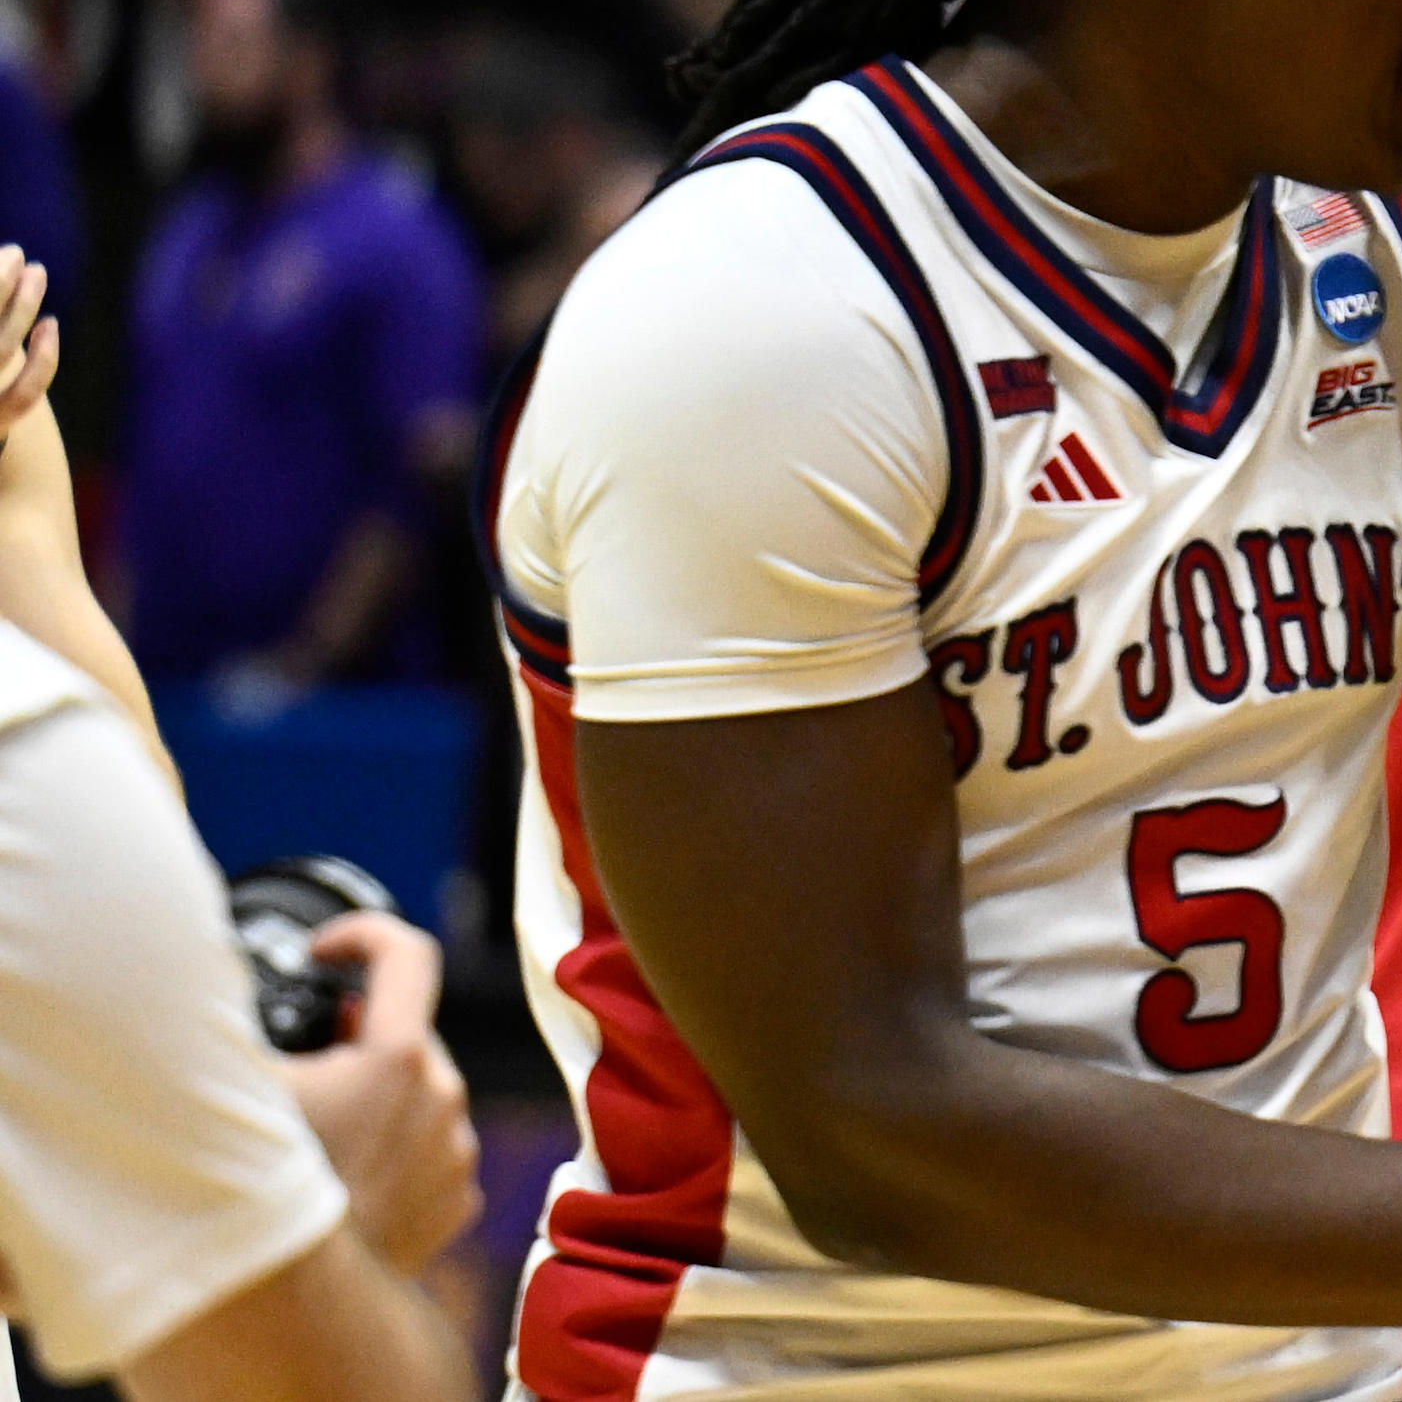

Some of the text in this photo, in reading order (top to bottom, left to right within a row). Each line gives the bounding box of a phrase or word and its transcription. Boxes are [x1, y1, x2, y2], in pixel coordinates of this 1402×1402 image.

[1310, 381, 1397, 417] EAST
[1315, 359, 1377, 394] BIG
[928, 596, 1091, 780] ST.
[1127, 787, 1287, 1073] 5
